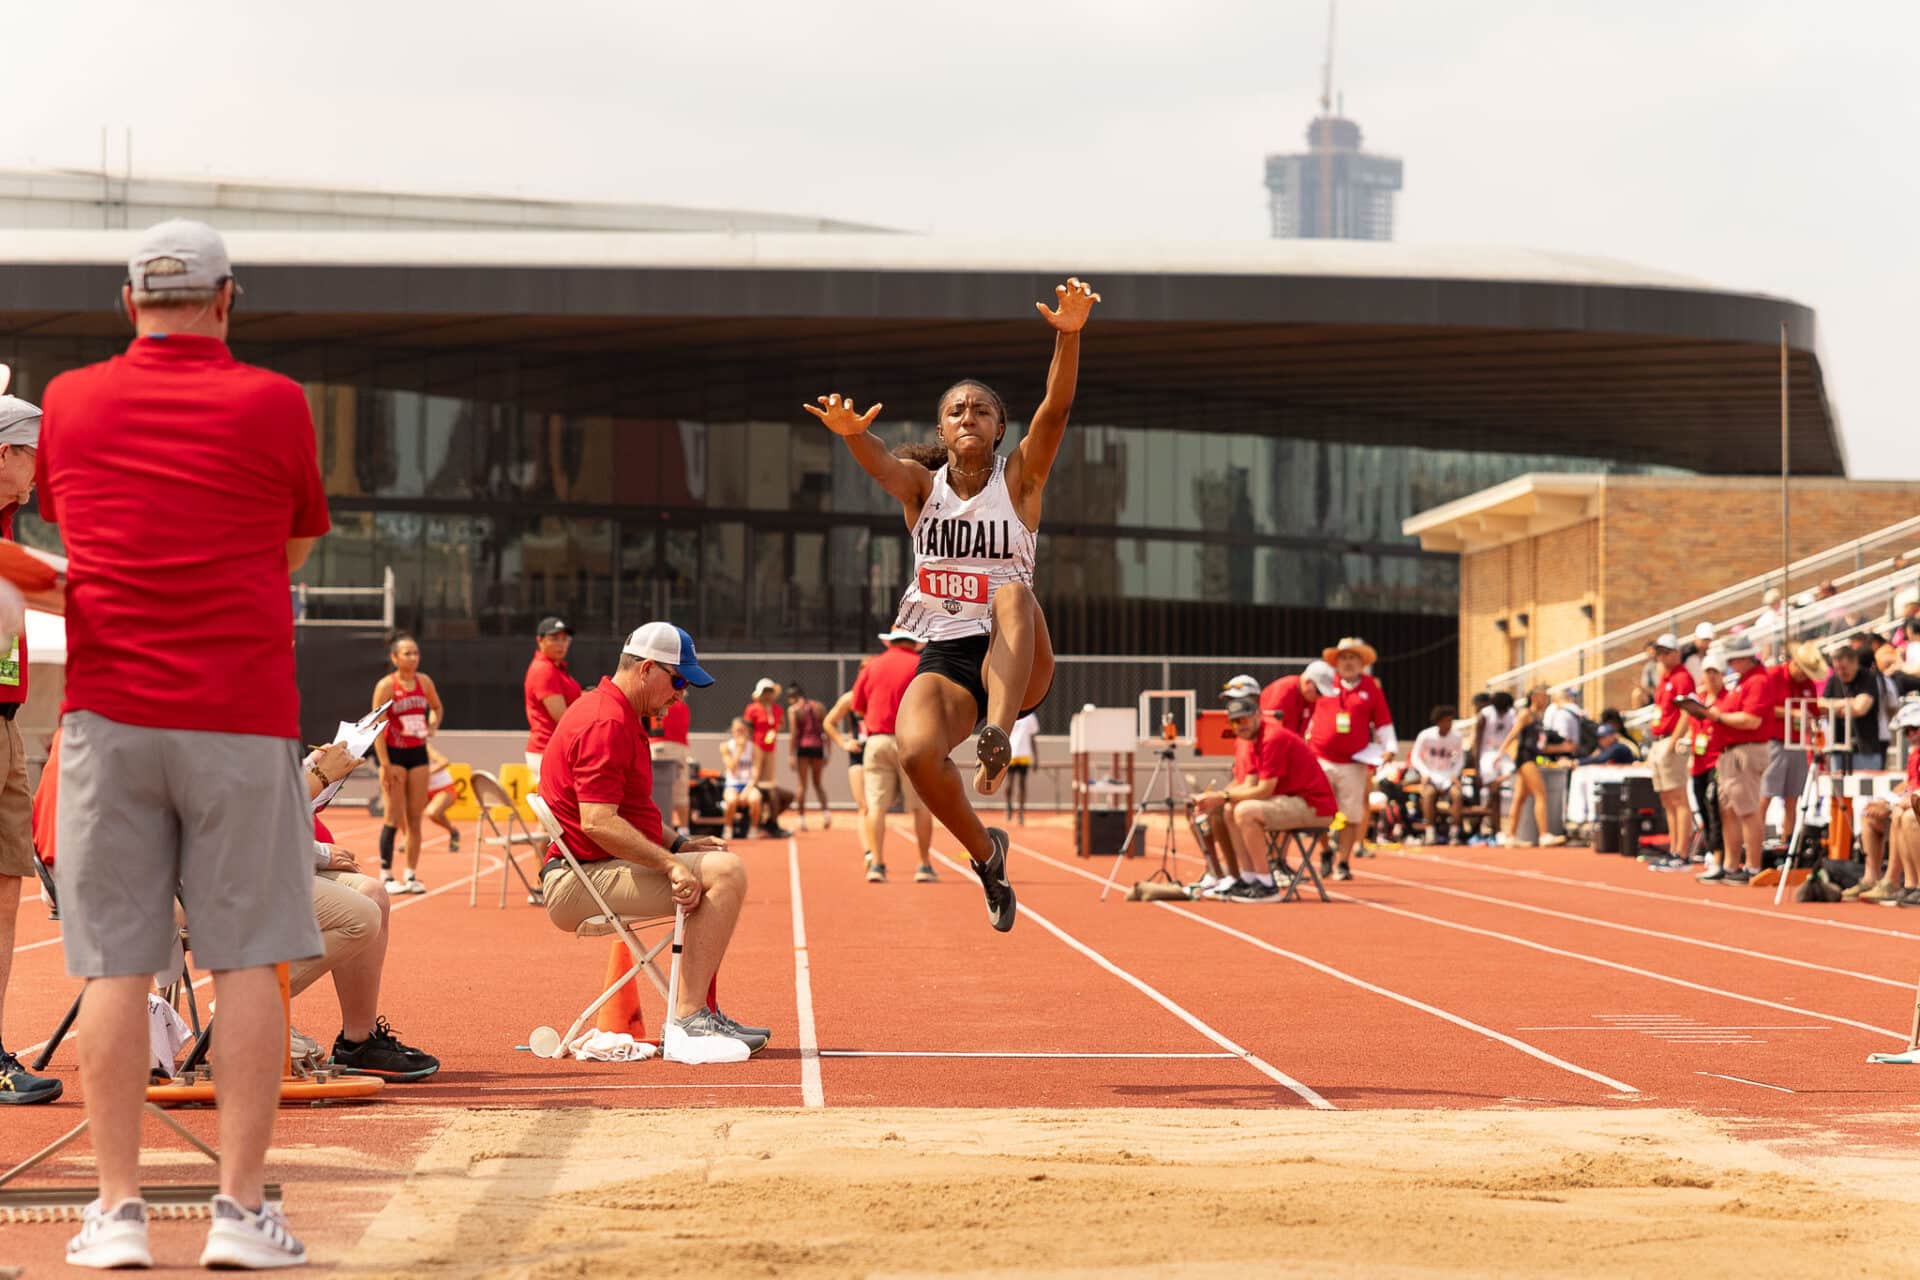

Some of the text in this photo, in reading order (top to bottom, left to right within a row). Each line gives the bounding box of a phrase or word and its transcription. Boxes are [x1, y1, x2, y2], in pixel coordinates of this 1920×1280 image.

[926, 572, 979, 600] 1189
[455, 777, 467, 801] 2
[509, 779, 518, 801] 1
